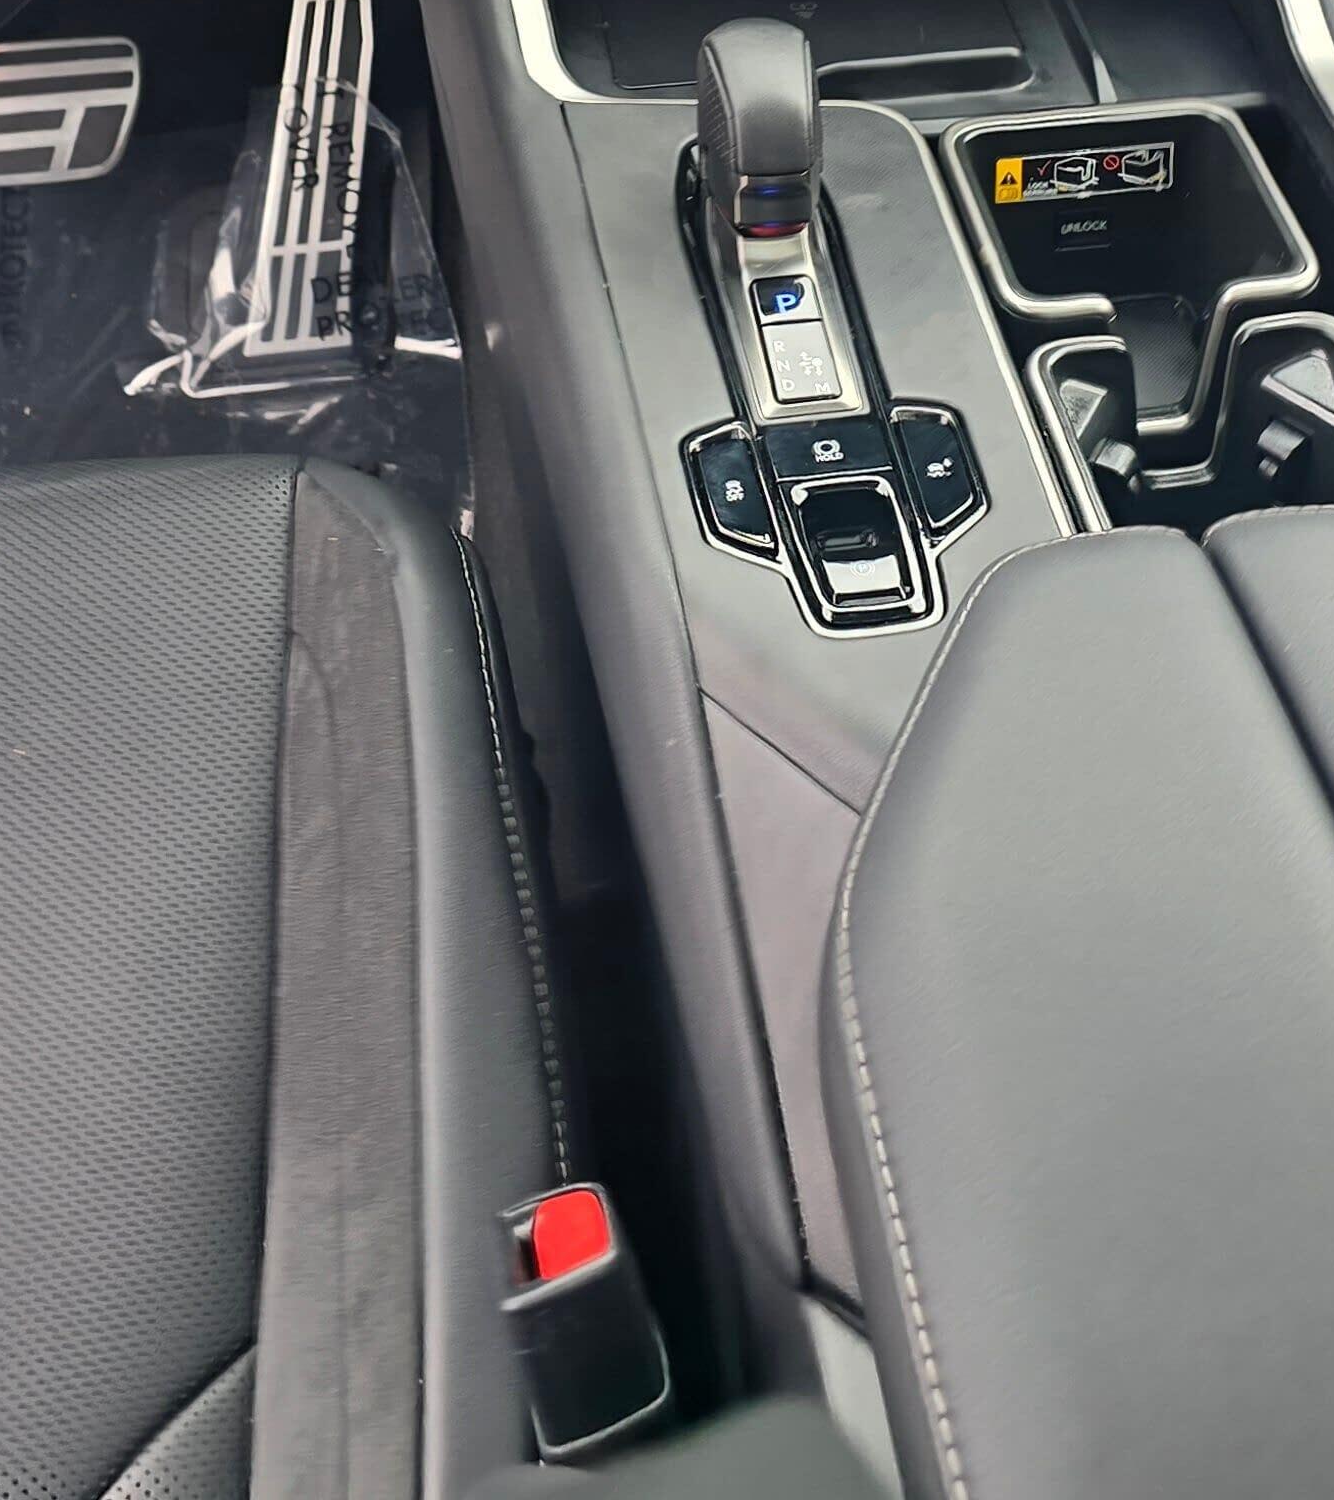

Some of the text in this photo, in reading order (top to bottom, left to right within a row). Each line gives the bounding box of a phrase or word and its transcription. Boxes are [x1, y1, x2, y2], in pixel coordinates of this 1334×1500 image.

[1060, 219, 1108, 235] UNLOCK
[775, 293, 797, 315] P
[773, 340, 786, 353] R
[776, 360, 791, 373] N
[781, 378, 796, 392] D
[813, 383, 831, 394] M
[814, 451, 845, 463] HOLD
